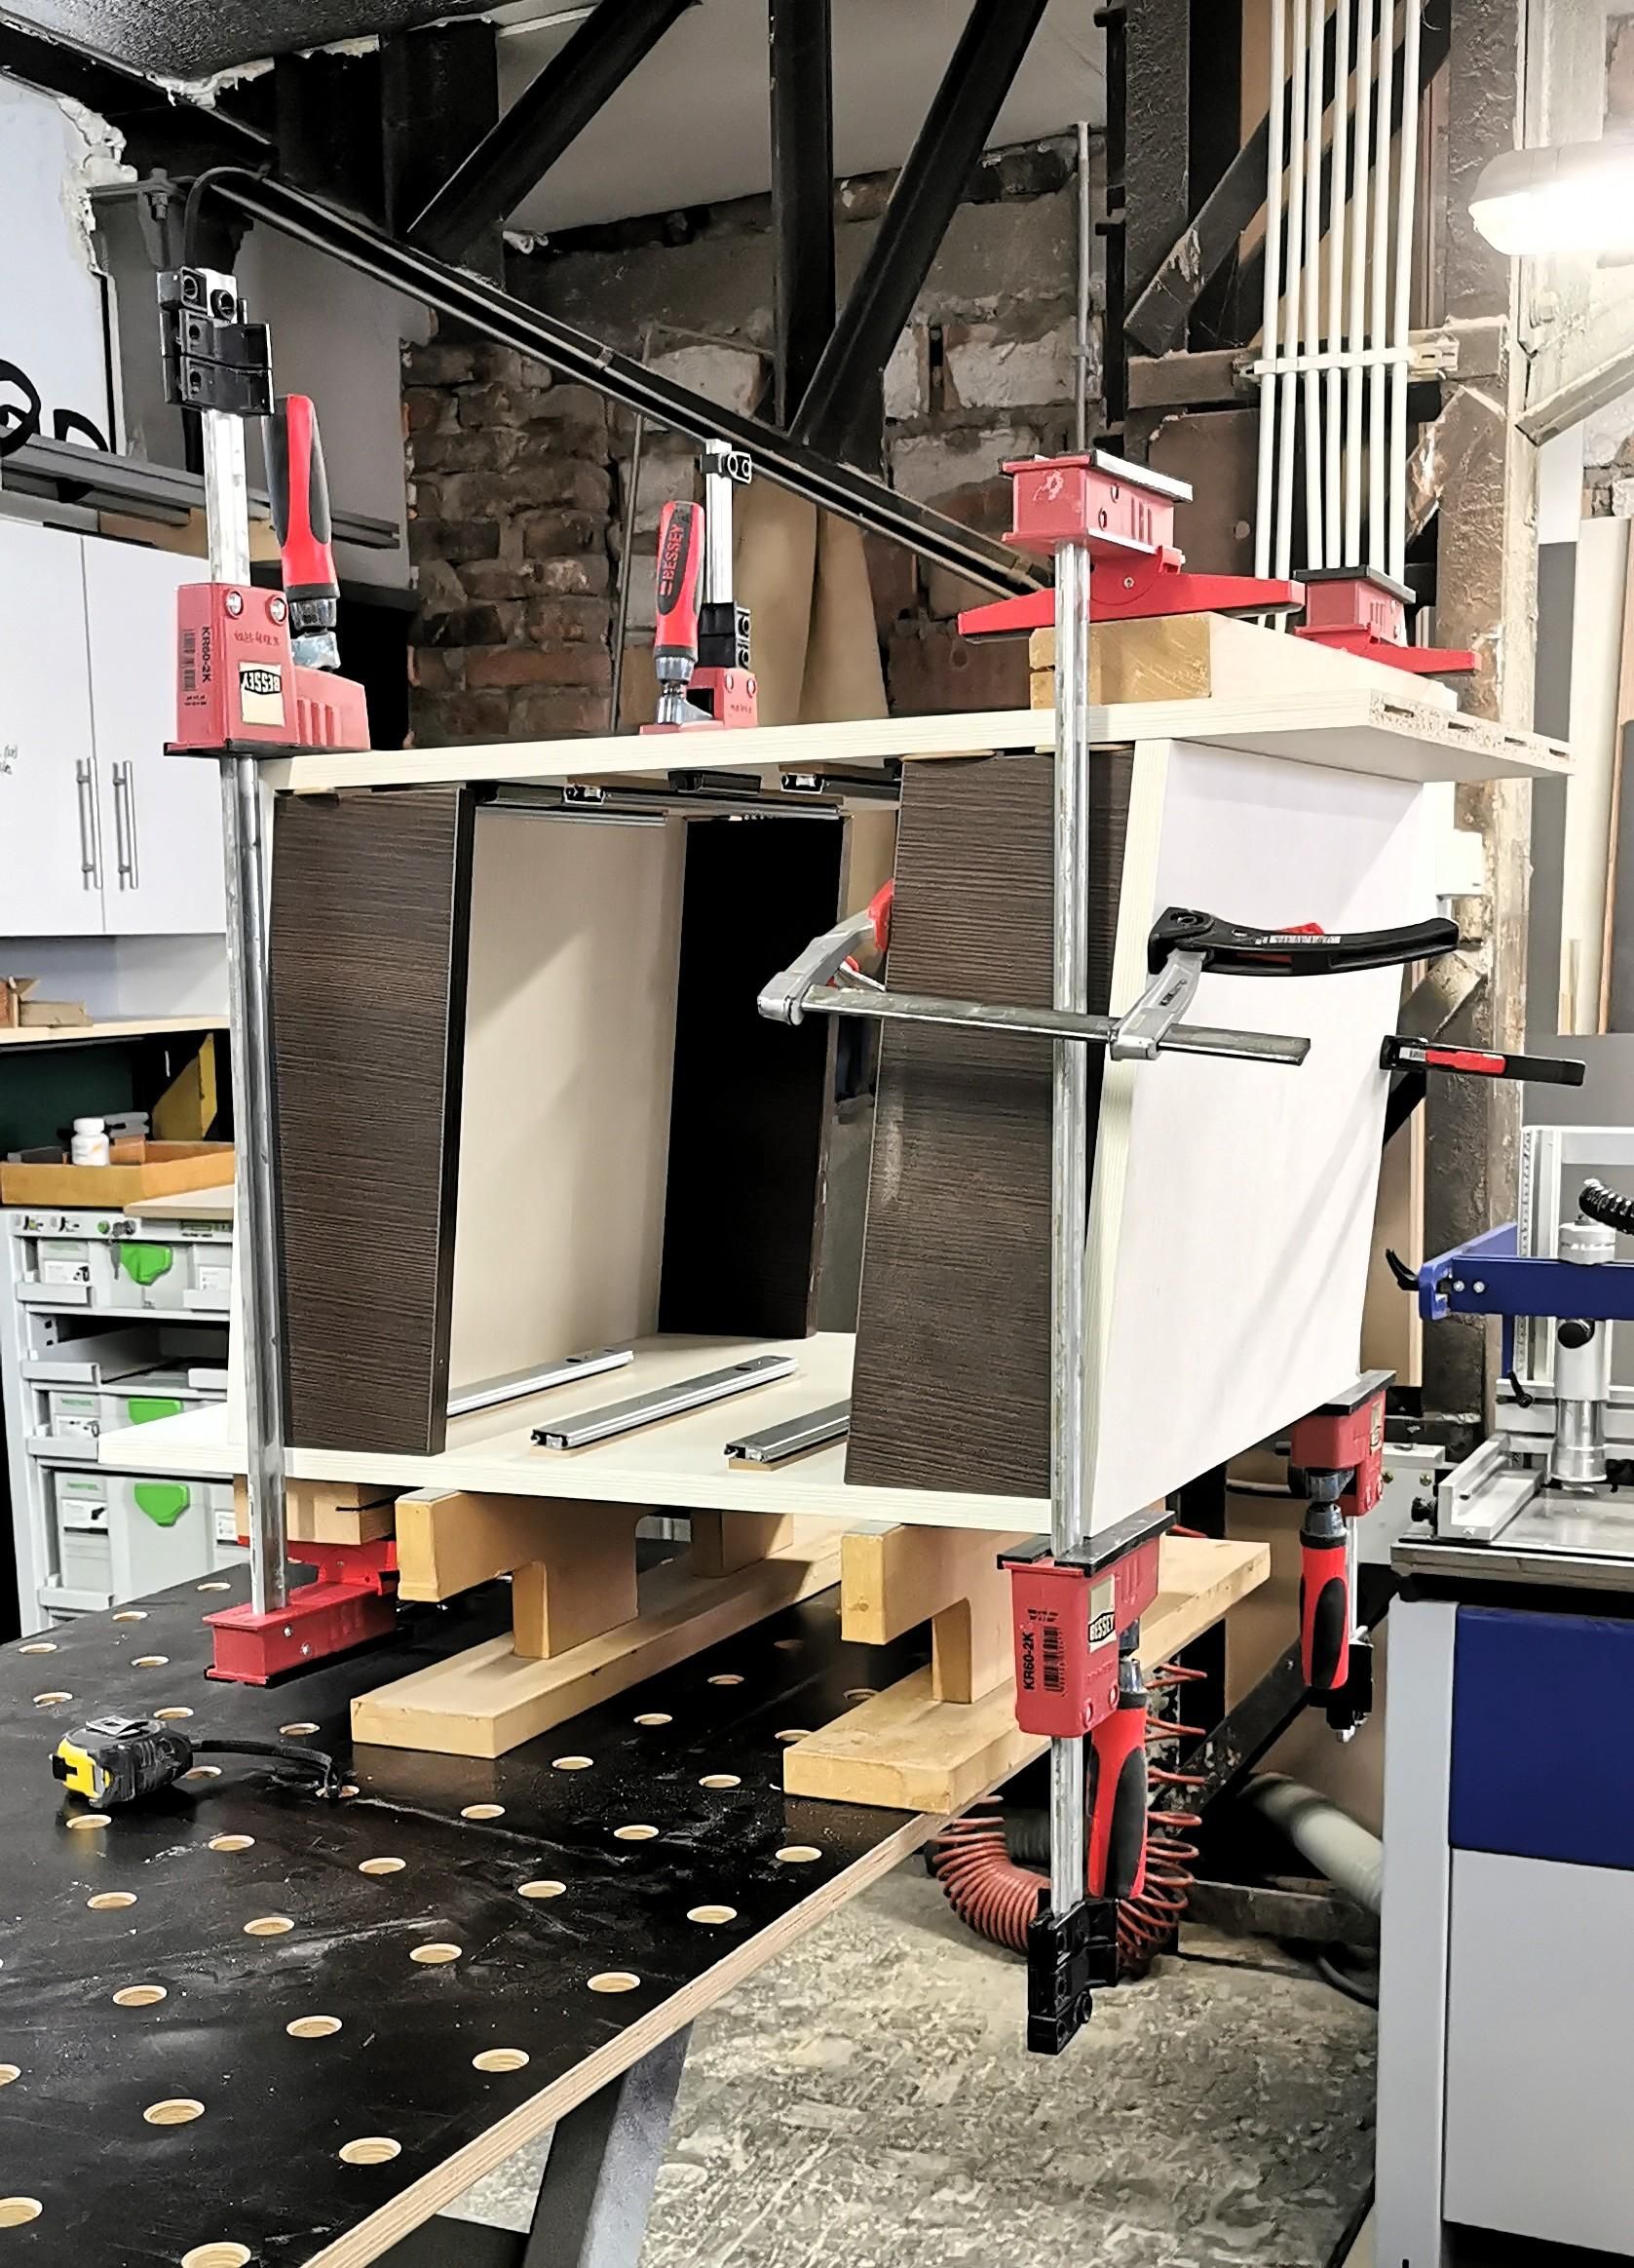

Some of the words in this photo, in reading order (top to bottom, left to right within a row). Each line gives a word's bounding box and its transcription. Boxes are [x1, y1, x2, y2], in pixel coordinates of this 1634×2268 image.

[663, 523, 684, 580] BESSEY
[244, 671, 281, 694] BESSEY
[1091, 1614, 1115, 1640] BESSEY
[1023, 1631, 1035, 1691] KR60-2K
